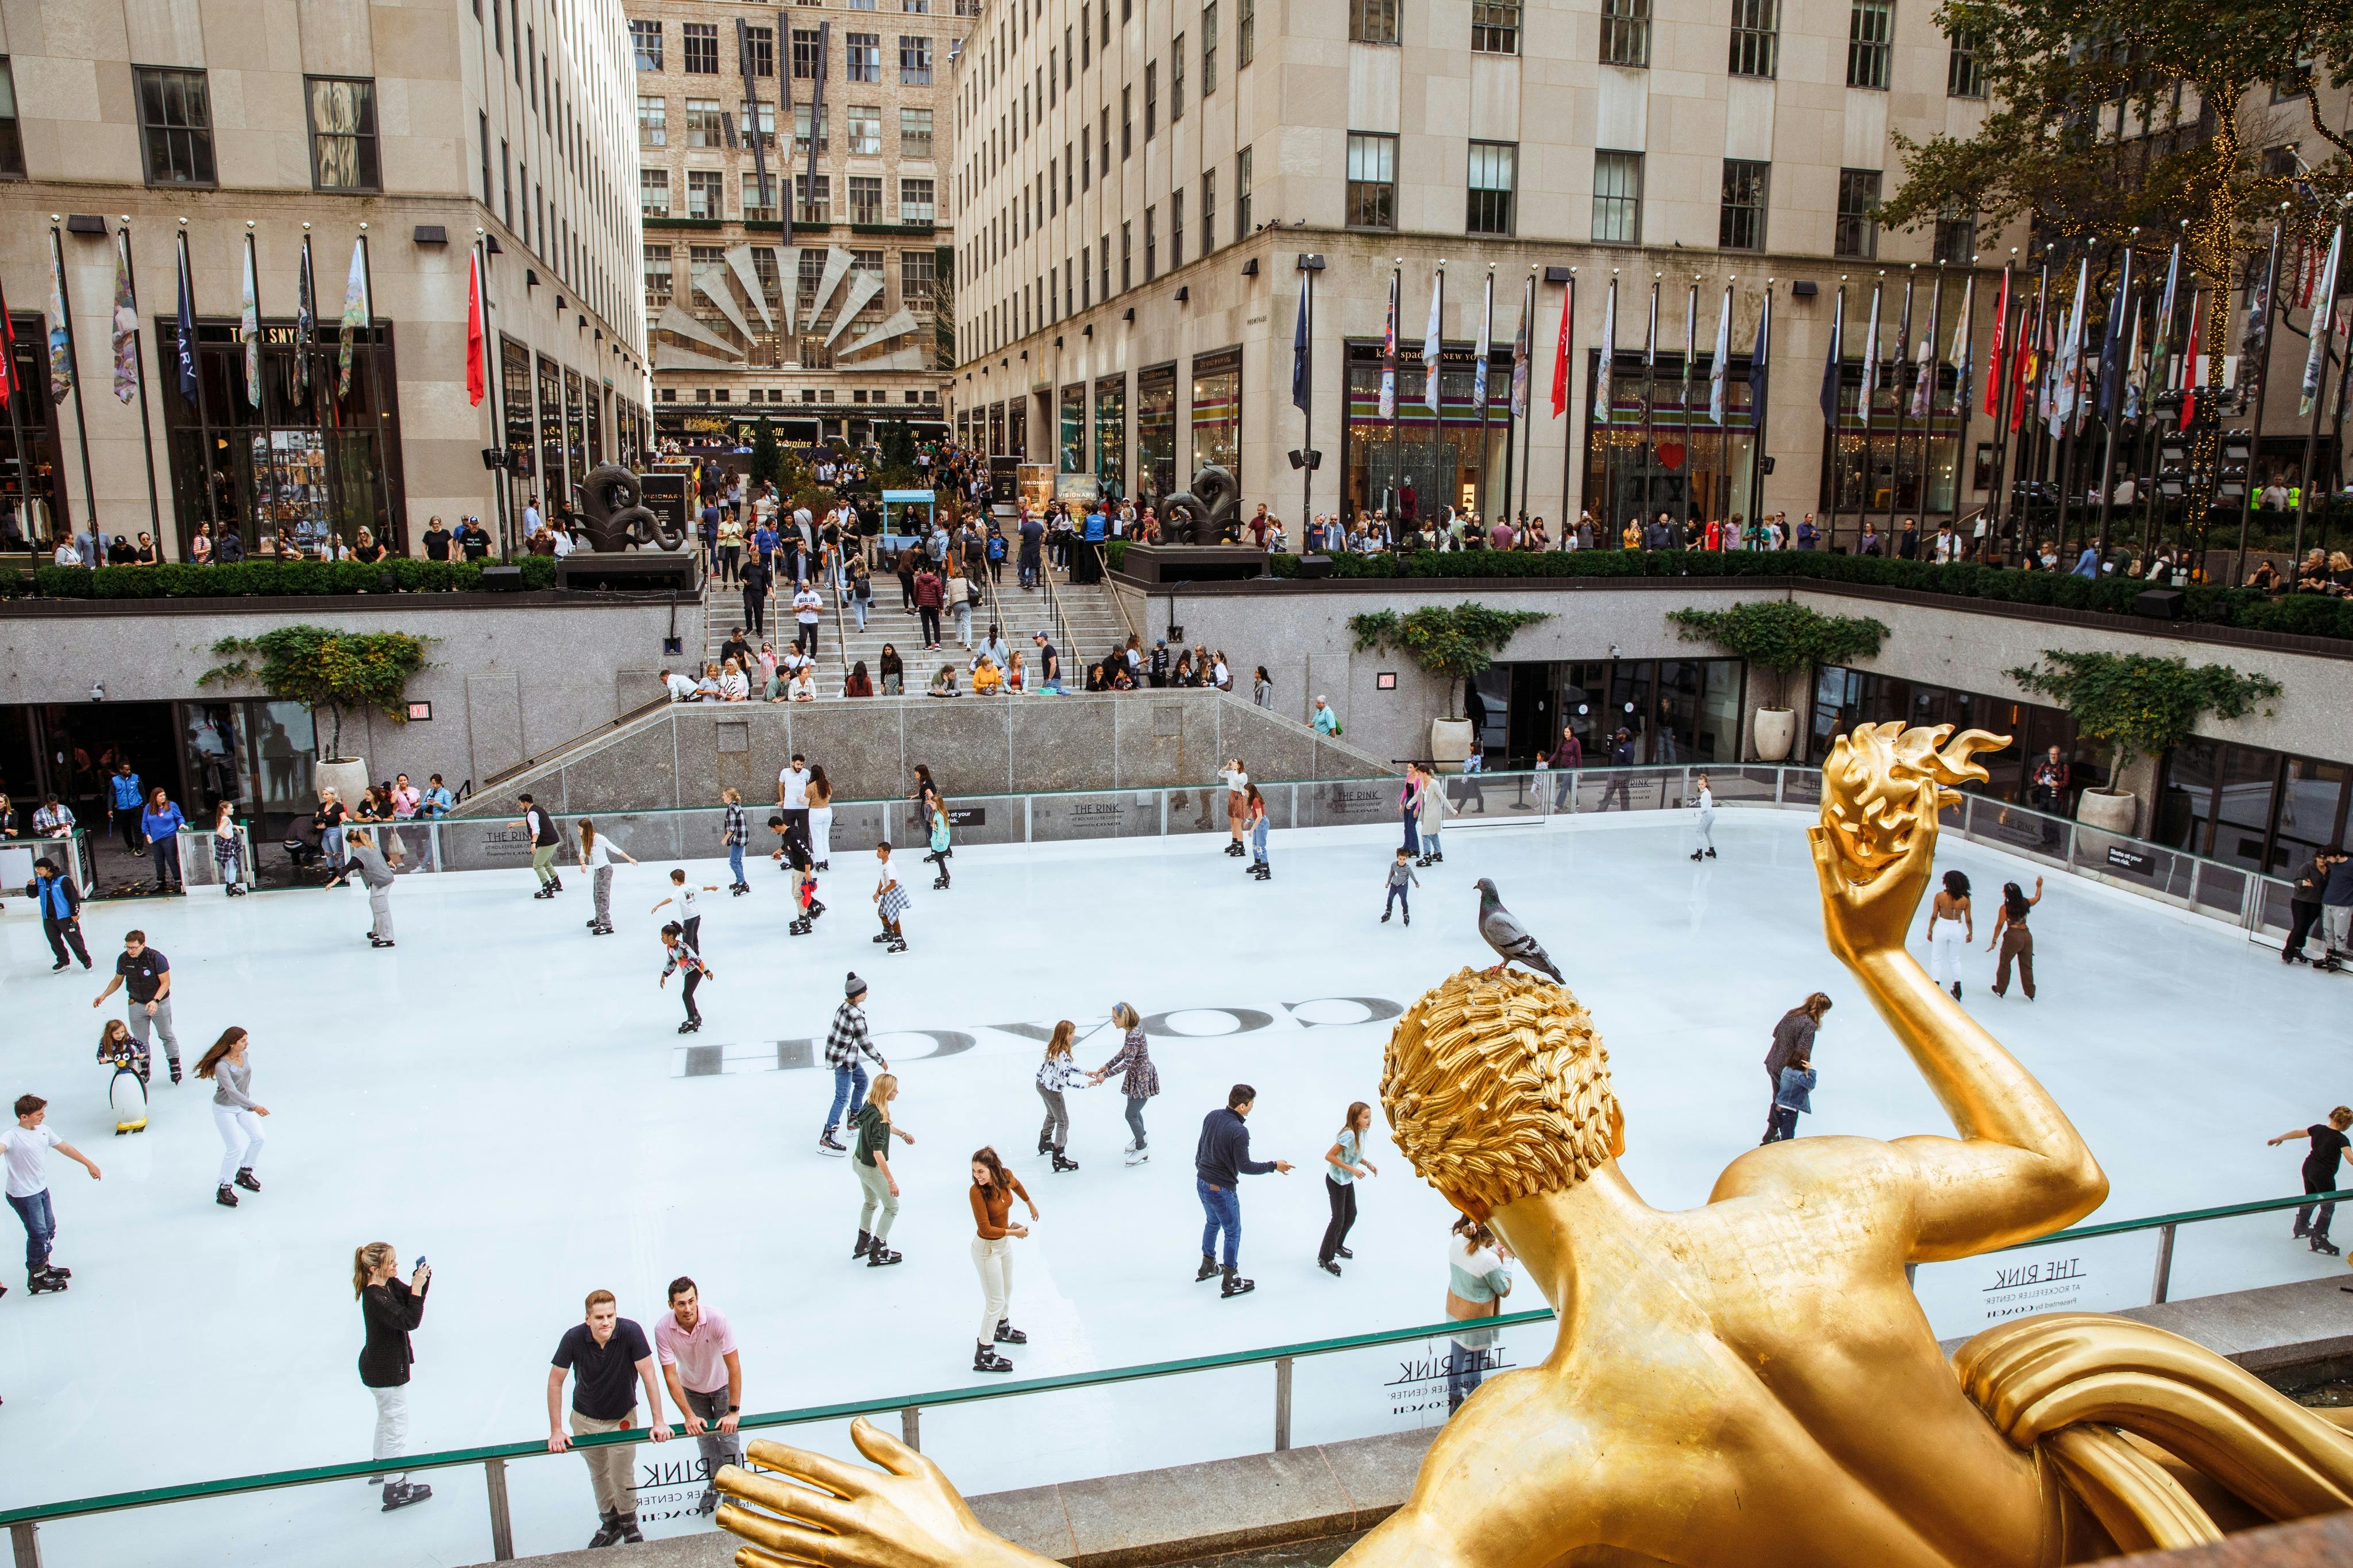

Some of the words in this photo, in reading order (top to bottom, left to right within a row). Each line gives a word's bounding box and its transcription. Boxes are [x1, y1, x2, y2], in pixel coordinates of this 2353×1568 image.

[270, 328, 313, 343] SNYE
[1401, 349, 1424, 362] spad
[1380, 677, 1394, 686] EXIT
[411, 705, 428, 717] EXIT
[1613, 780, 1627, 789] THE
[1630, 779, 1650, 787] RINK
[1338, 792, 1353, 801] THE
[1357, 791, 1378, 800] RINK
[1075, 805, 1091, 814] THE
[1096, 804, 1119, 813] RINK
[487, 832, 507, 842] THE
[511, 831, 531, 841] RIN
[2110, 848, 2124, 857] Skate
